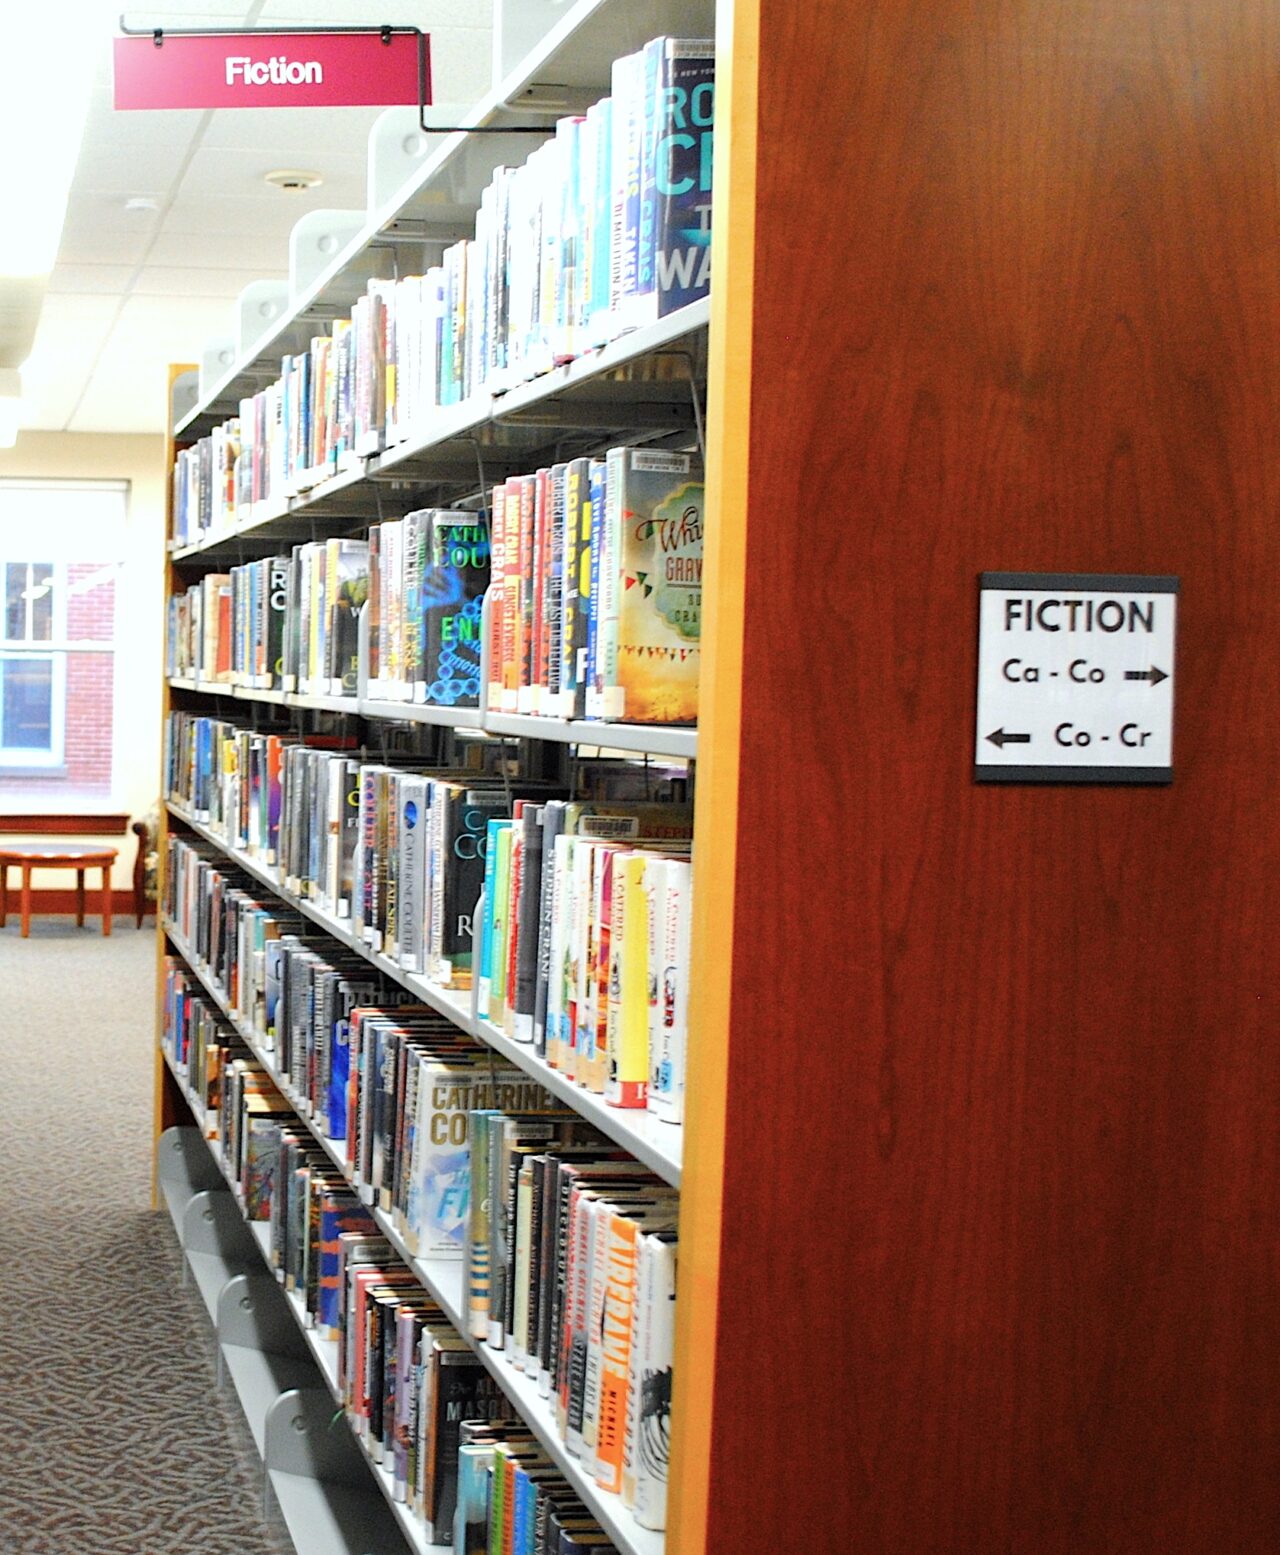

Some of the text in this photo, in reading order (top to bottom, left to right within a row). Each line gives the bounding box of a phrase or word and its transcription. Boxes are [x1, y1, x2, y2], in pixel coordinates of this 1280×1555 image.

[225, 57, 322, 85] Fiction
[492, 543, 506, 602] CRAIS
[504, 585, 517, 620] SUNSET
[1004, 599, 1154, 633] FICTION
[503, 622, 516, 663] EXPRESS
[1002, 658, 1039, 683] Ca
[1069, 659, 1105, 683] Co
[1055, 722, 1091, 747] Co
[1119, 723, 1151, 747] Cr
[402, 833, 415, 954] CATHERINE COULTER
[545, 849, 556, 924] STEPHEN
[615, 884, 625, 942] CATERED
[541, 926, 552, 982] CRANE
[431, 1083, 551, 1111] CATHERINE
[430, 1112, 467, 1146] CO
[557, 1185, 569, 1291] DISCLOSURE
[573, 1339, 583, 1381] STATE
[604, 1231, 633, 1448] AIRFRAME MICHAEL
